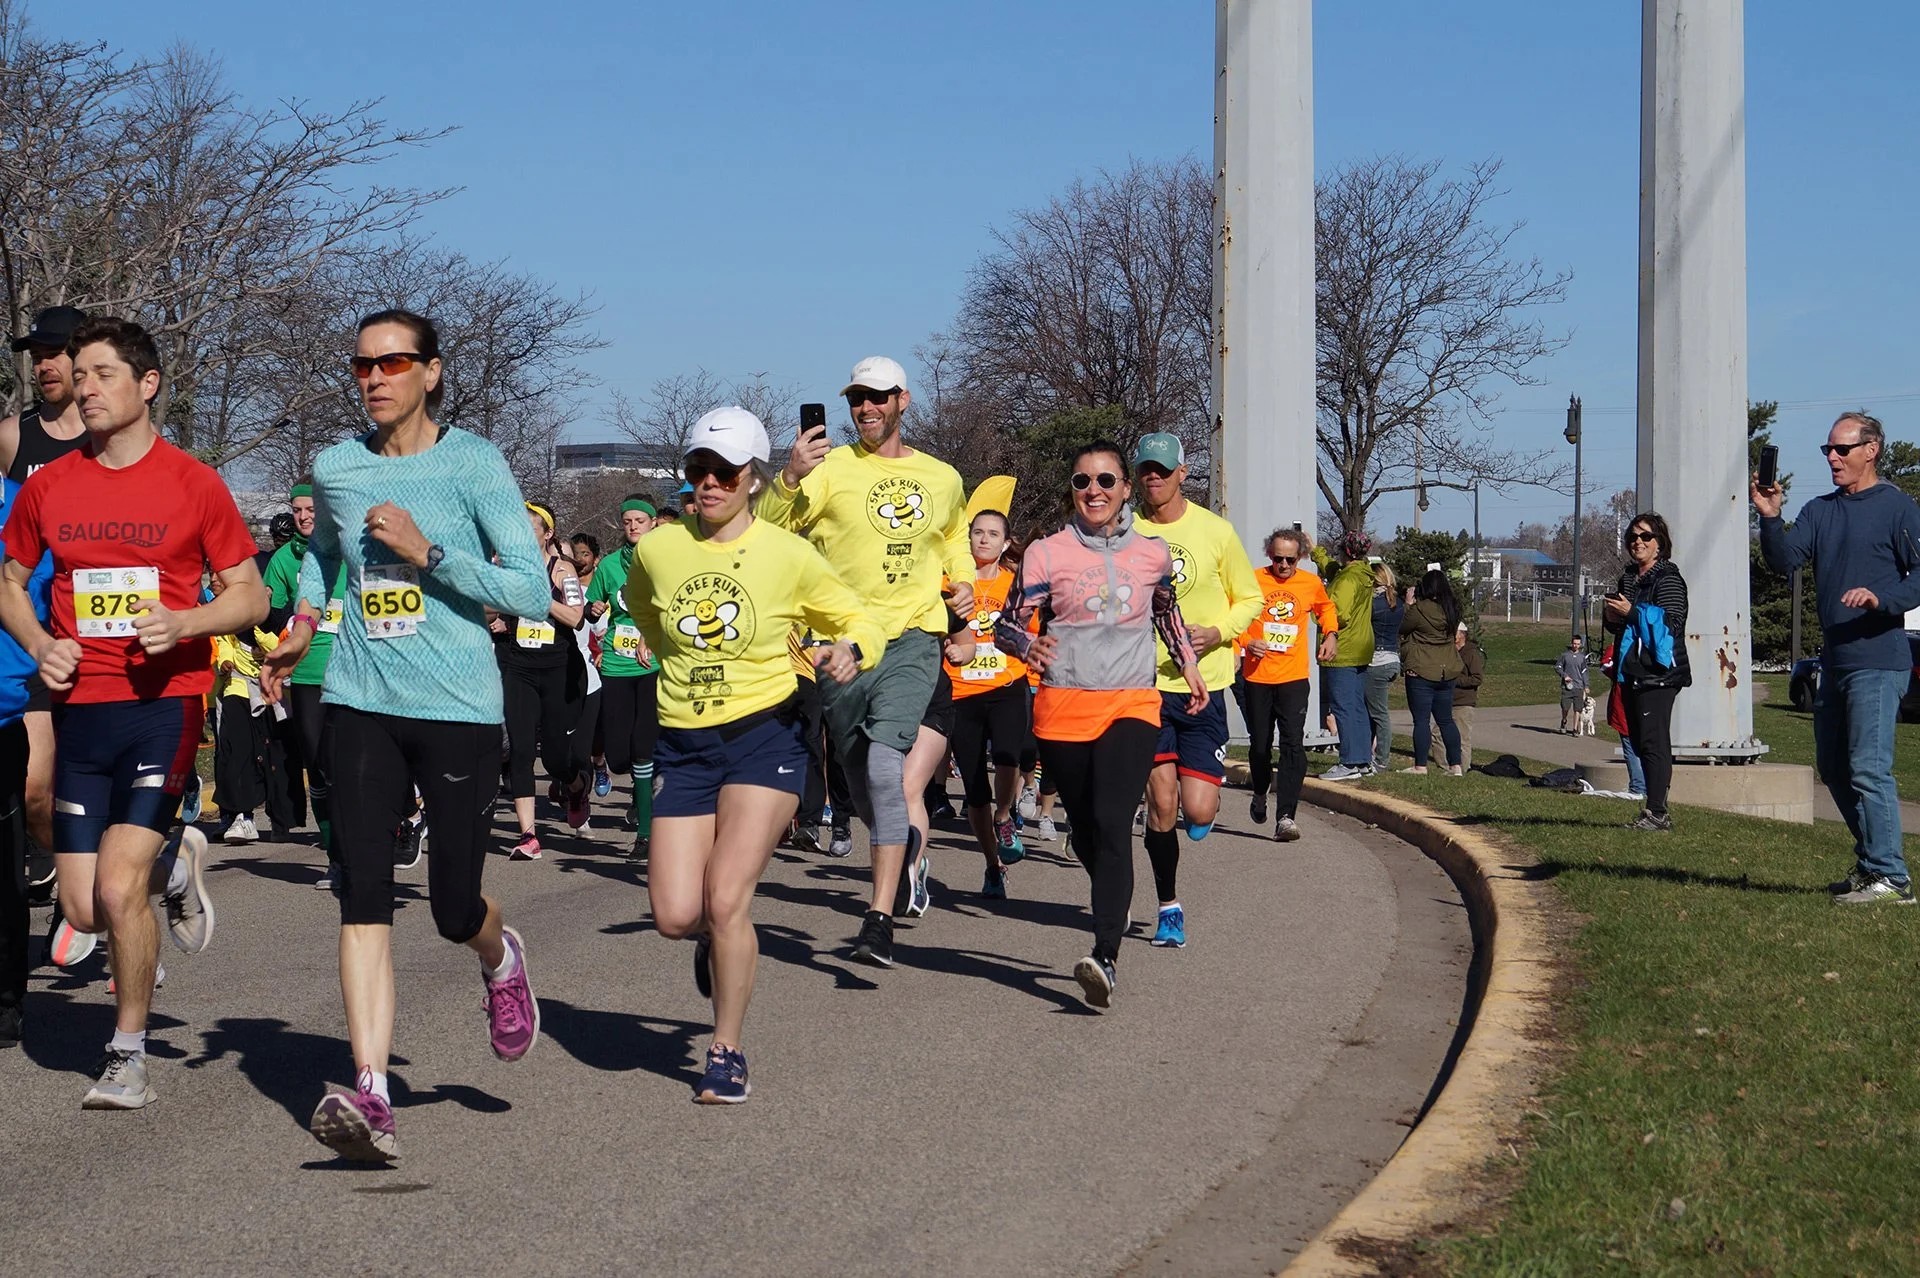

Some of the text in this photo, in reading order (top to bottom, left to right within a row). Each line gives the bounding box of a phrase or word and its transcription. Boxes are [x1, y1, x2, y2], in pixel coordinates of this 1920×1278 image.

[878, 479, 896, 492] BEE
[899, 479, 921, 492] RUN
[364, 589, 421, 616] 650
[672, 577, 741, 615] 5K BEE RUN
[90, 593, 141, 616] 878
[528, 628, 541, 640] 21
[1269, 633, 1291, 644] 707
[621, 637, 638, 649] 86
[969, 656, 998, 669] 248
